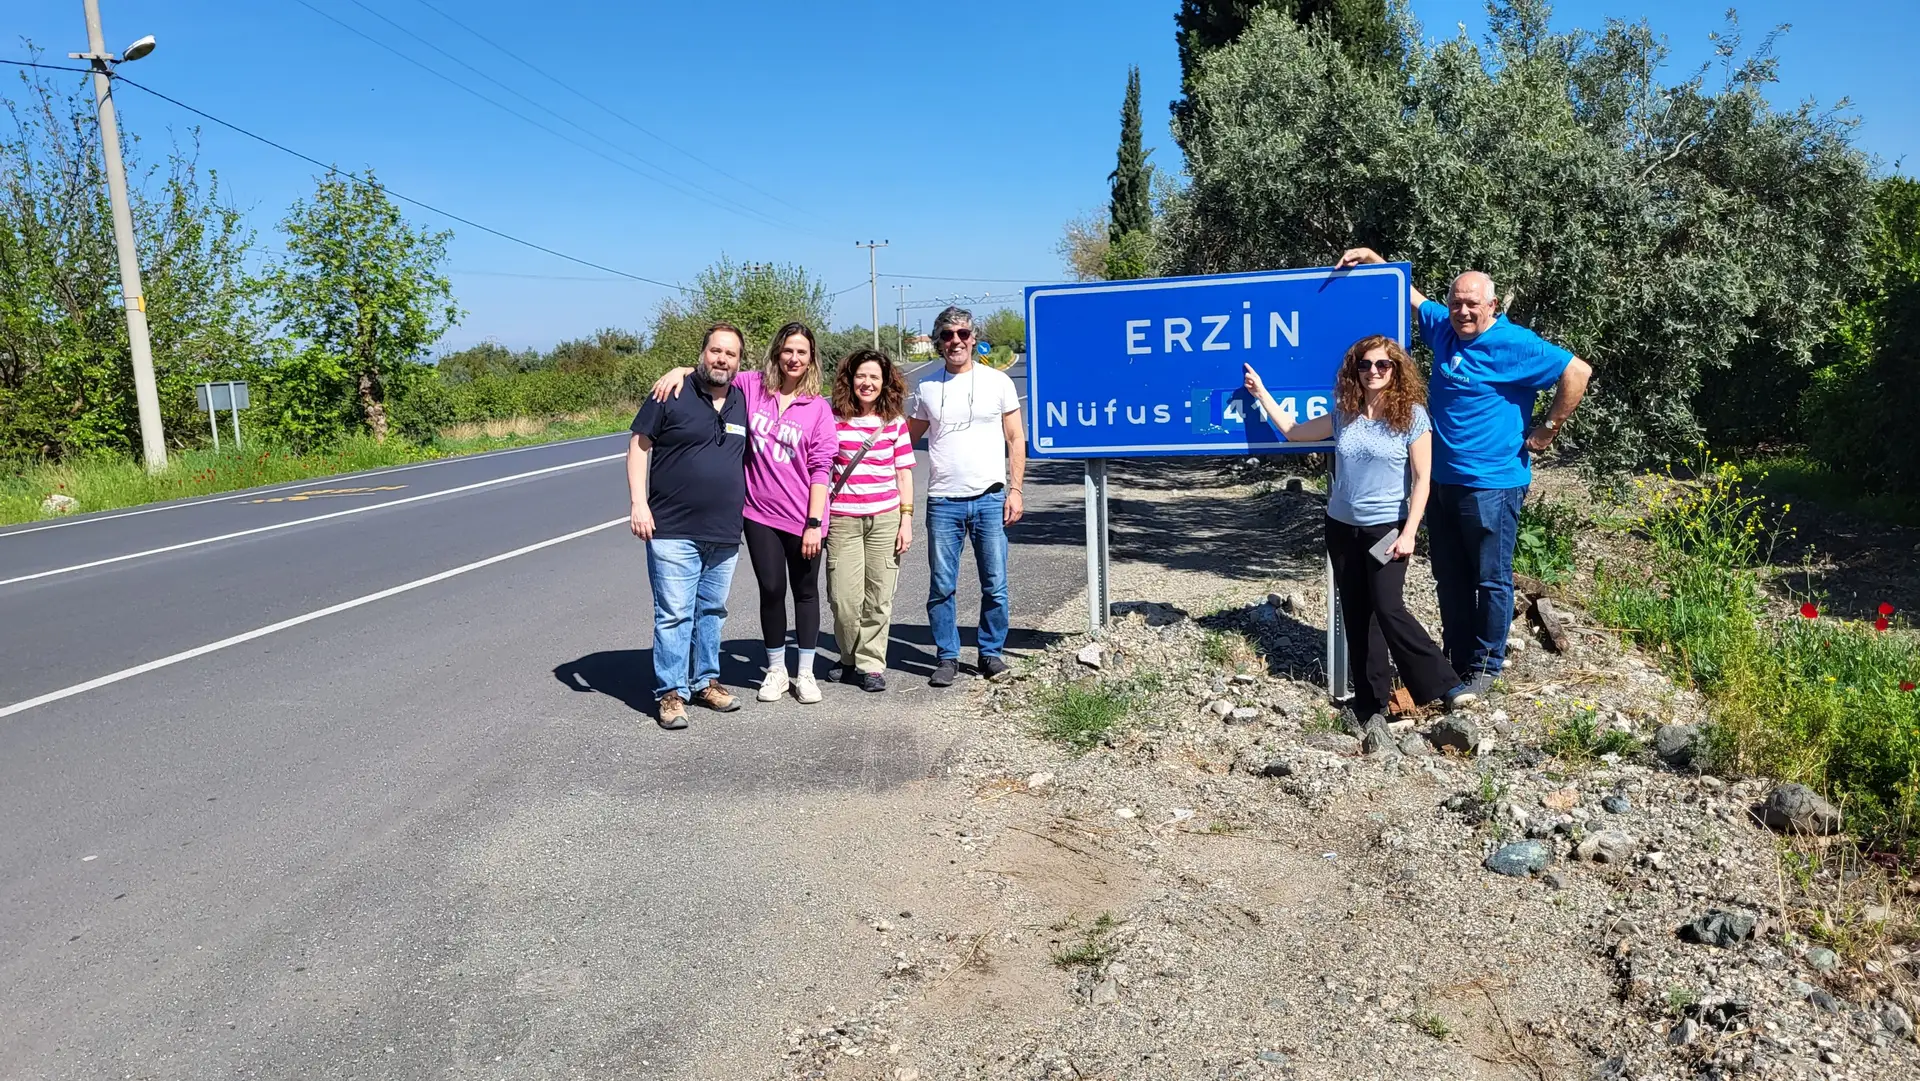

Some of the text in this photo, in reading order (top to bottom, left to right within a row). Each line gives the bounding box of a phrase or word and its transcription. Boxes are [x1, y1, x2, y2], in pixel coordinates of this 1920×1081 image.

[1126, 301, 1299, 355] ERZİN
[750, 412, 803, 447] TURN
[772, 442, 796, 465] UP
